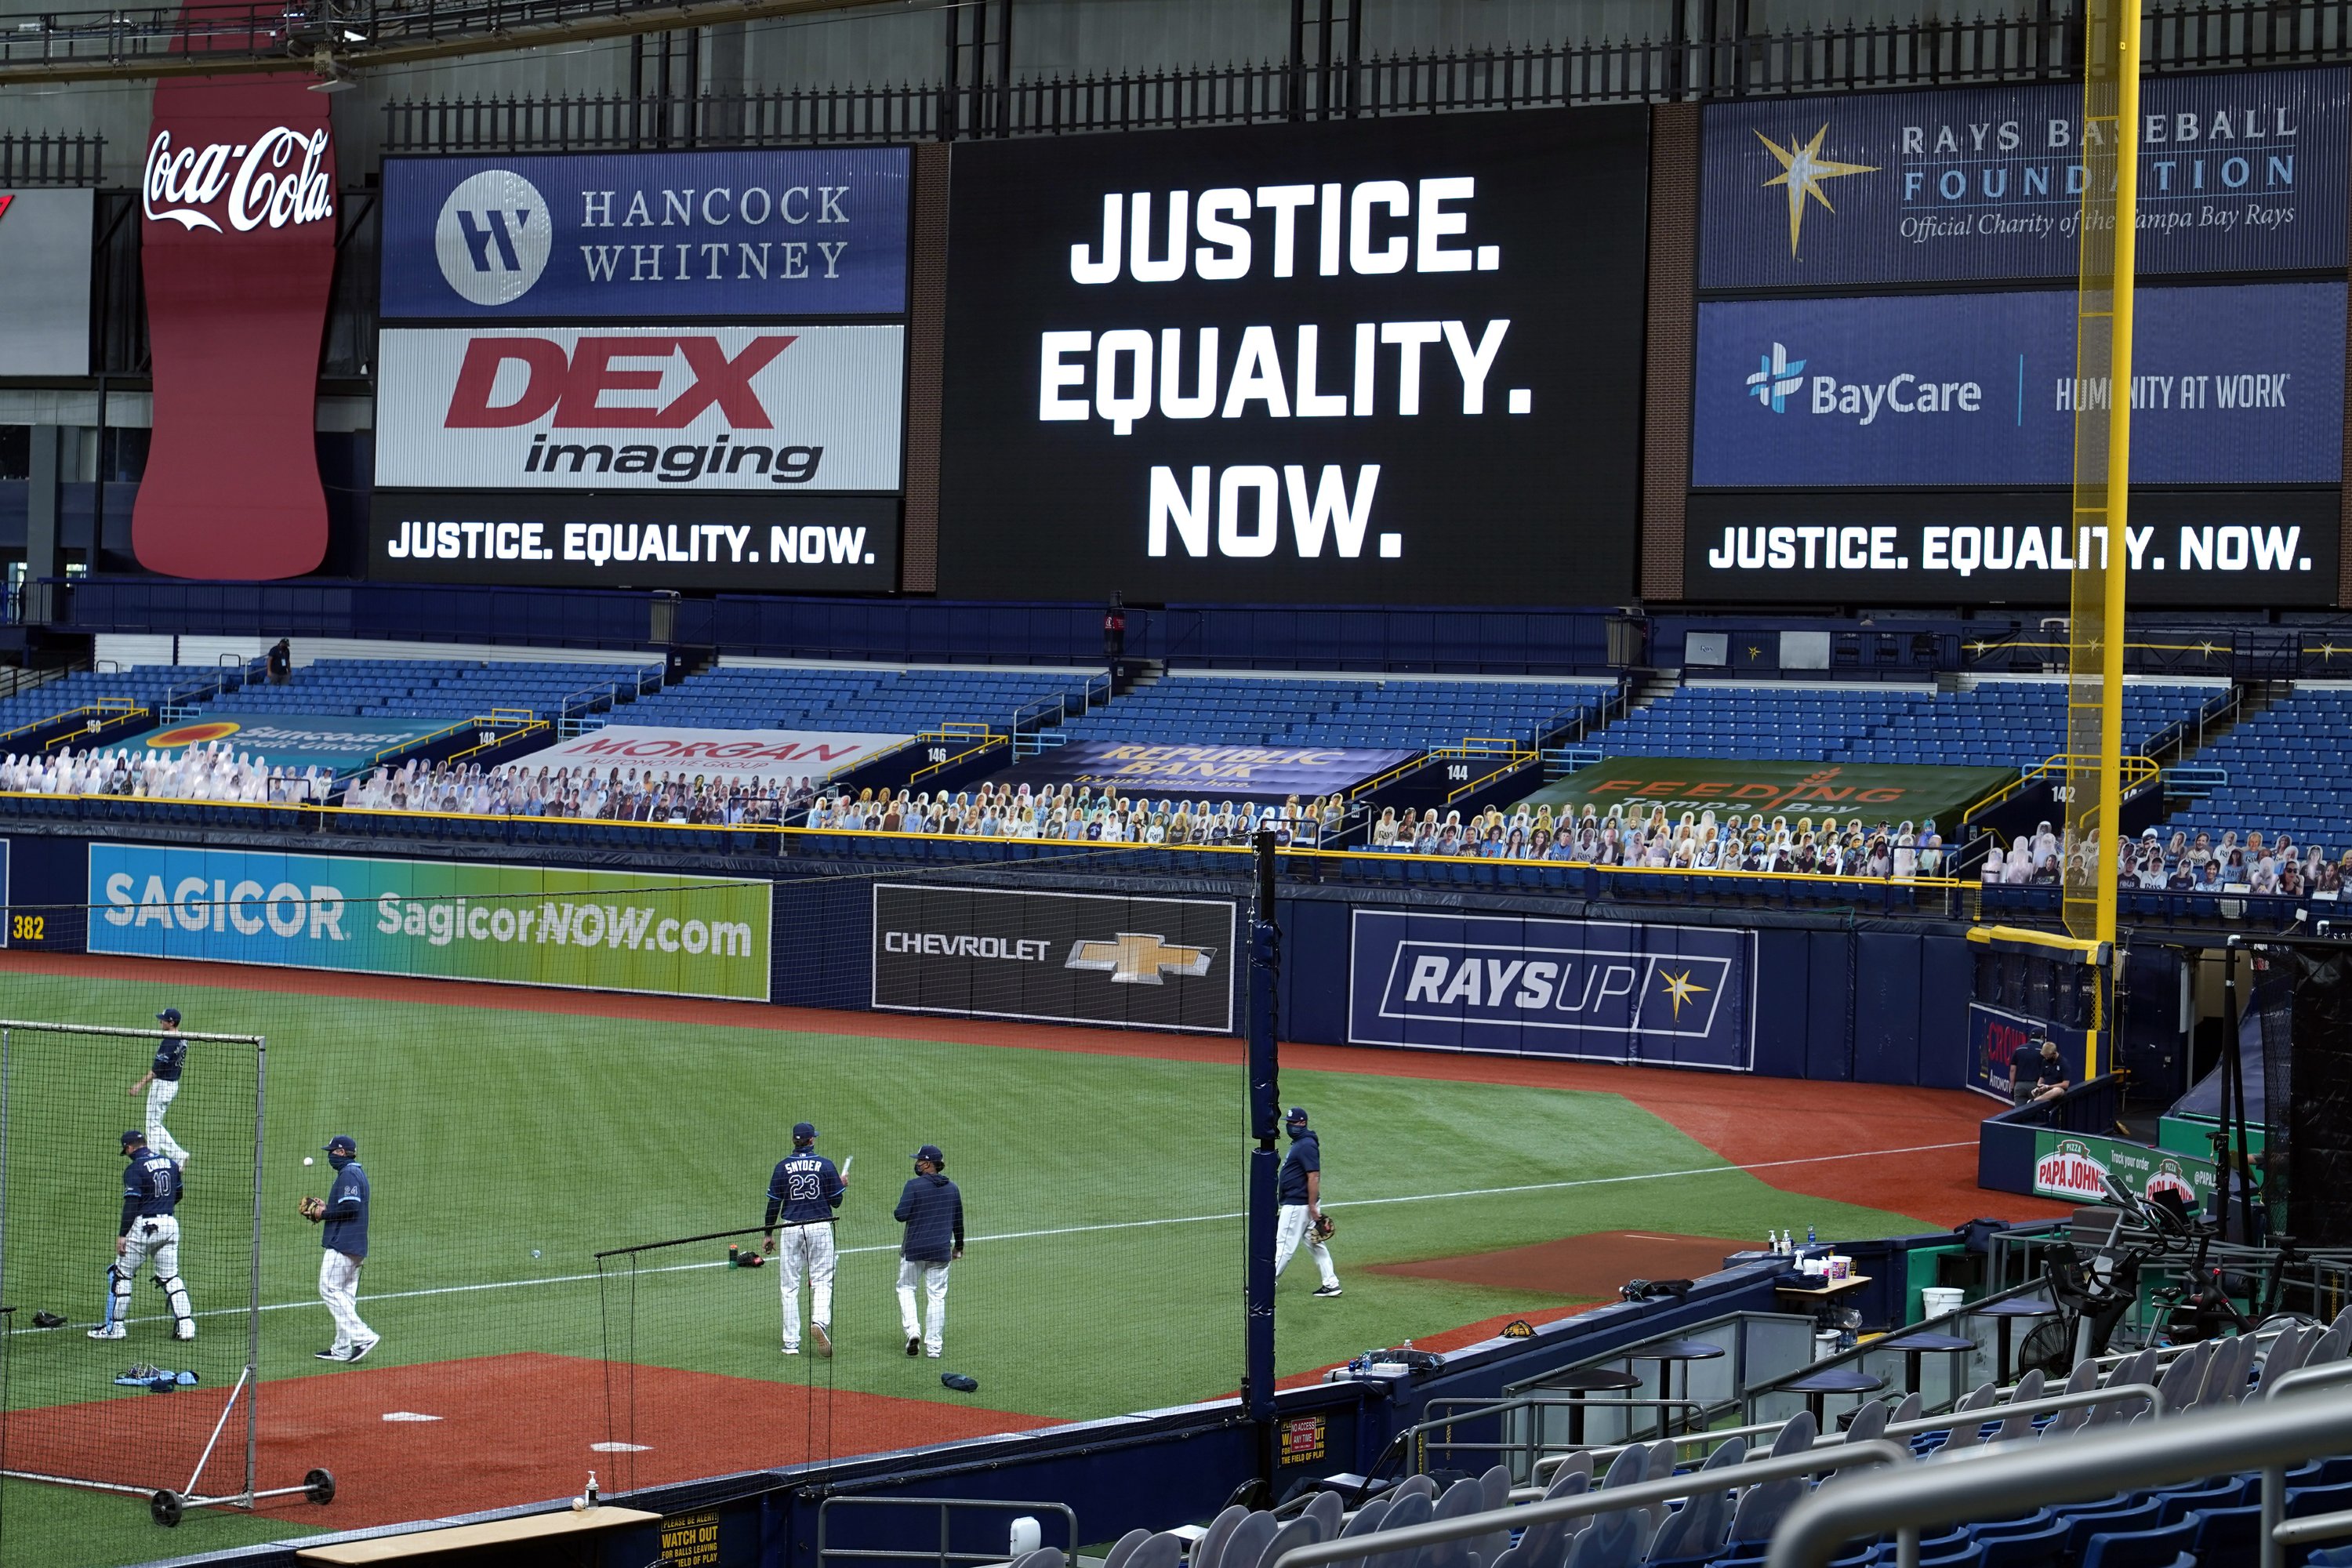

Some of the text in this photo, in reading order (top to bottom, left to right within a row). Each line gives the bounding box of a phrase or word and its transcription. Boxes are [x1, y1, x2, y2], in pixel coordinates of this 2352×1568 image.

[1902, 107, 2298, 154] RAYS BAEBALL
[1904, 154, 2295, 201] FOUNDTION
[581, 186, 850, 227] HANCOCK
[1070, 176, 1500, 285] JUSTICE.
[1900, 214, 1973, 243] Official
[1978, 210, 2054, 239] Charity
[2060, 209, 2082, 238] of
[2134, 209, 2193, 235] ampa
[2199, 206, 2239, 234] Bay
[2245, 203, 2295, 232] Rays
[580, 241, 848, 282] WHITNEY
[444, 335, 800, 429] DEX
[1039, 319, 1531, 436] EQUALITY.
[1812, 374, 1981, 426] BayCare
[2056, 376, 2173, 412] HUMNITY
[2180, 376, 2209, 409] AT
[524, 434, 823, 484] imaging
[1148, 464, 1402, 558] NOW.
[388, 521, 875, 566] JUSTICE. EQUALITY. NOW.
[1709, 525, 2312, 577] JUSTICE. EQUALITY. NOW.
[479, 731, 495, 746] 148
[563, 739, 861, 761] MORGAN
[588, 757, 771, 771] AUTOMOTIVE GROUP
[928, 747, 946, 762] 146
[1098, 745, 1345, 766] REPUBLIC
[1114, 760, 1274, 779] BANK
[1447, 765, 1468, 780] 144
[1588, 780, 1906, 811] FEEDING
[1621, 797, 1863, 815] Tampa Bay
[2052, 786, 2075, 803] 142
[104, 872, 345, 942] SAGICOR
[13, 914, 44, 941] 382
[885, 931, 1051, 961] CHEVROLET
[2066, 1143, 2082, 1152] PIZZA
[785, 1160, 822, 1174] SNYDER
[2039, 1160, 2067, 1187] PAPA
[153, 1171, 172, 1198] 10
[344, 1185, 358, 1196] 24
[789, 1174, 820, 1200] 23
[1298, 1421, 1315, 1431] ACCESS
[1302, 1433, 1312, 1443] TIME
[1282, 1450, 1324, 1465] THE FIELD OF PLAY
[663, 1512, 717, 1529] PLEASE BE ALERT!
[662, 1526, 718, 1548] WATCH OUT
[662, 1542, 717, 1560] FOR BALLS LEAVING
[693, 1555, 701, 1565] OF
[702, 1552, 718, 1563] PLAY
